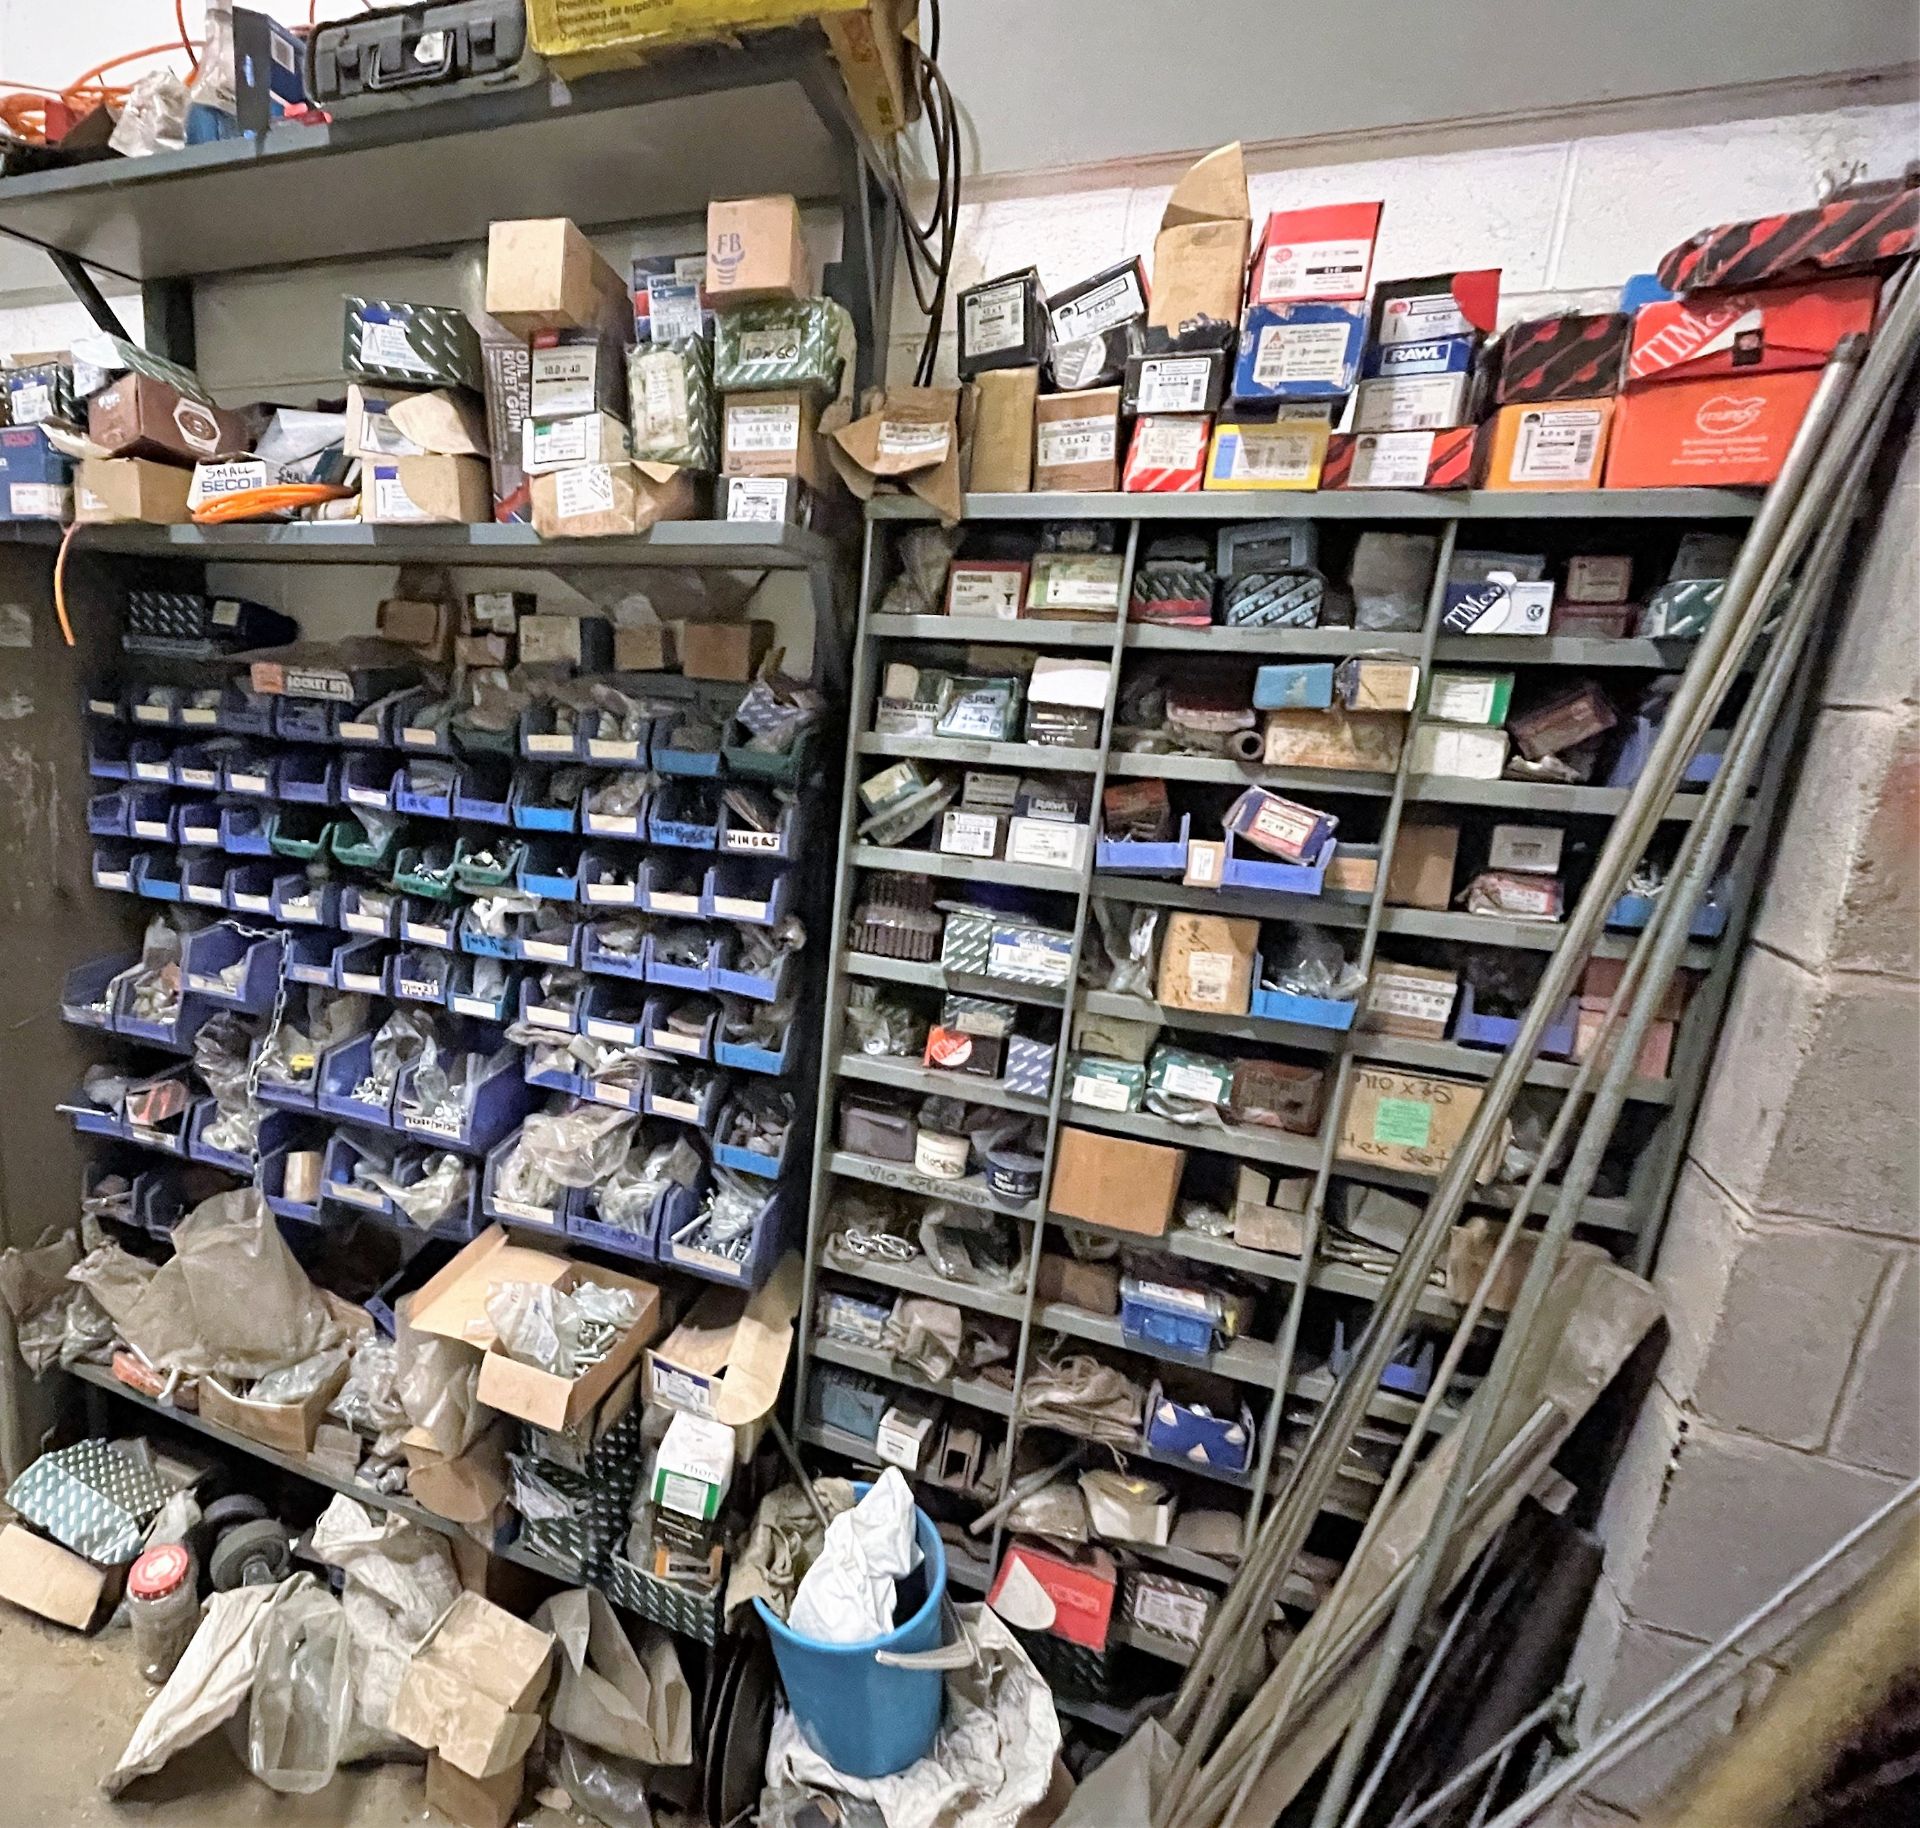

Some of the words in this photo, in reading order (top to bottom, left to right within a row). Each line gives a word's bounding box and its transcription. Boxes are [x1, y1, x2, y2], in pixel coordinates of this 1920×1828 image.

[717, 233, 743, 255] FB
[1391, 345, 1441, 363] RAWL
[204, 466, 256, 480] SMALL
[202, 477, 250, 492] SECO
[1443, 586, 1503, 631] TIMco
